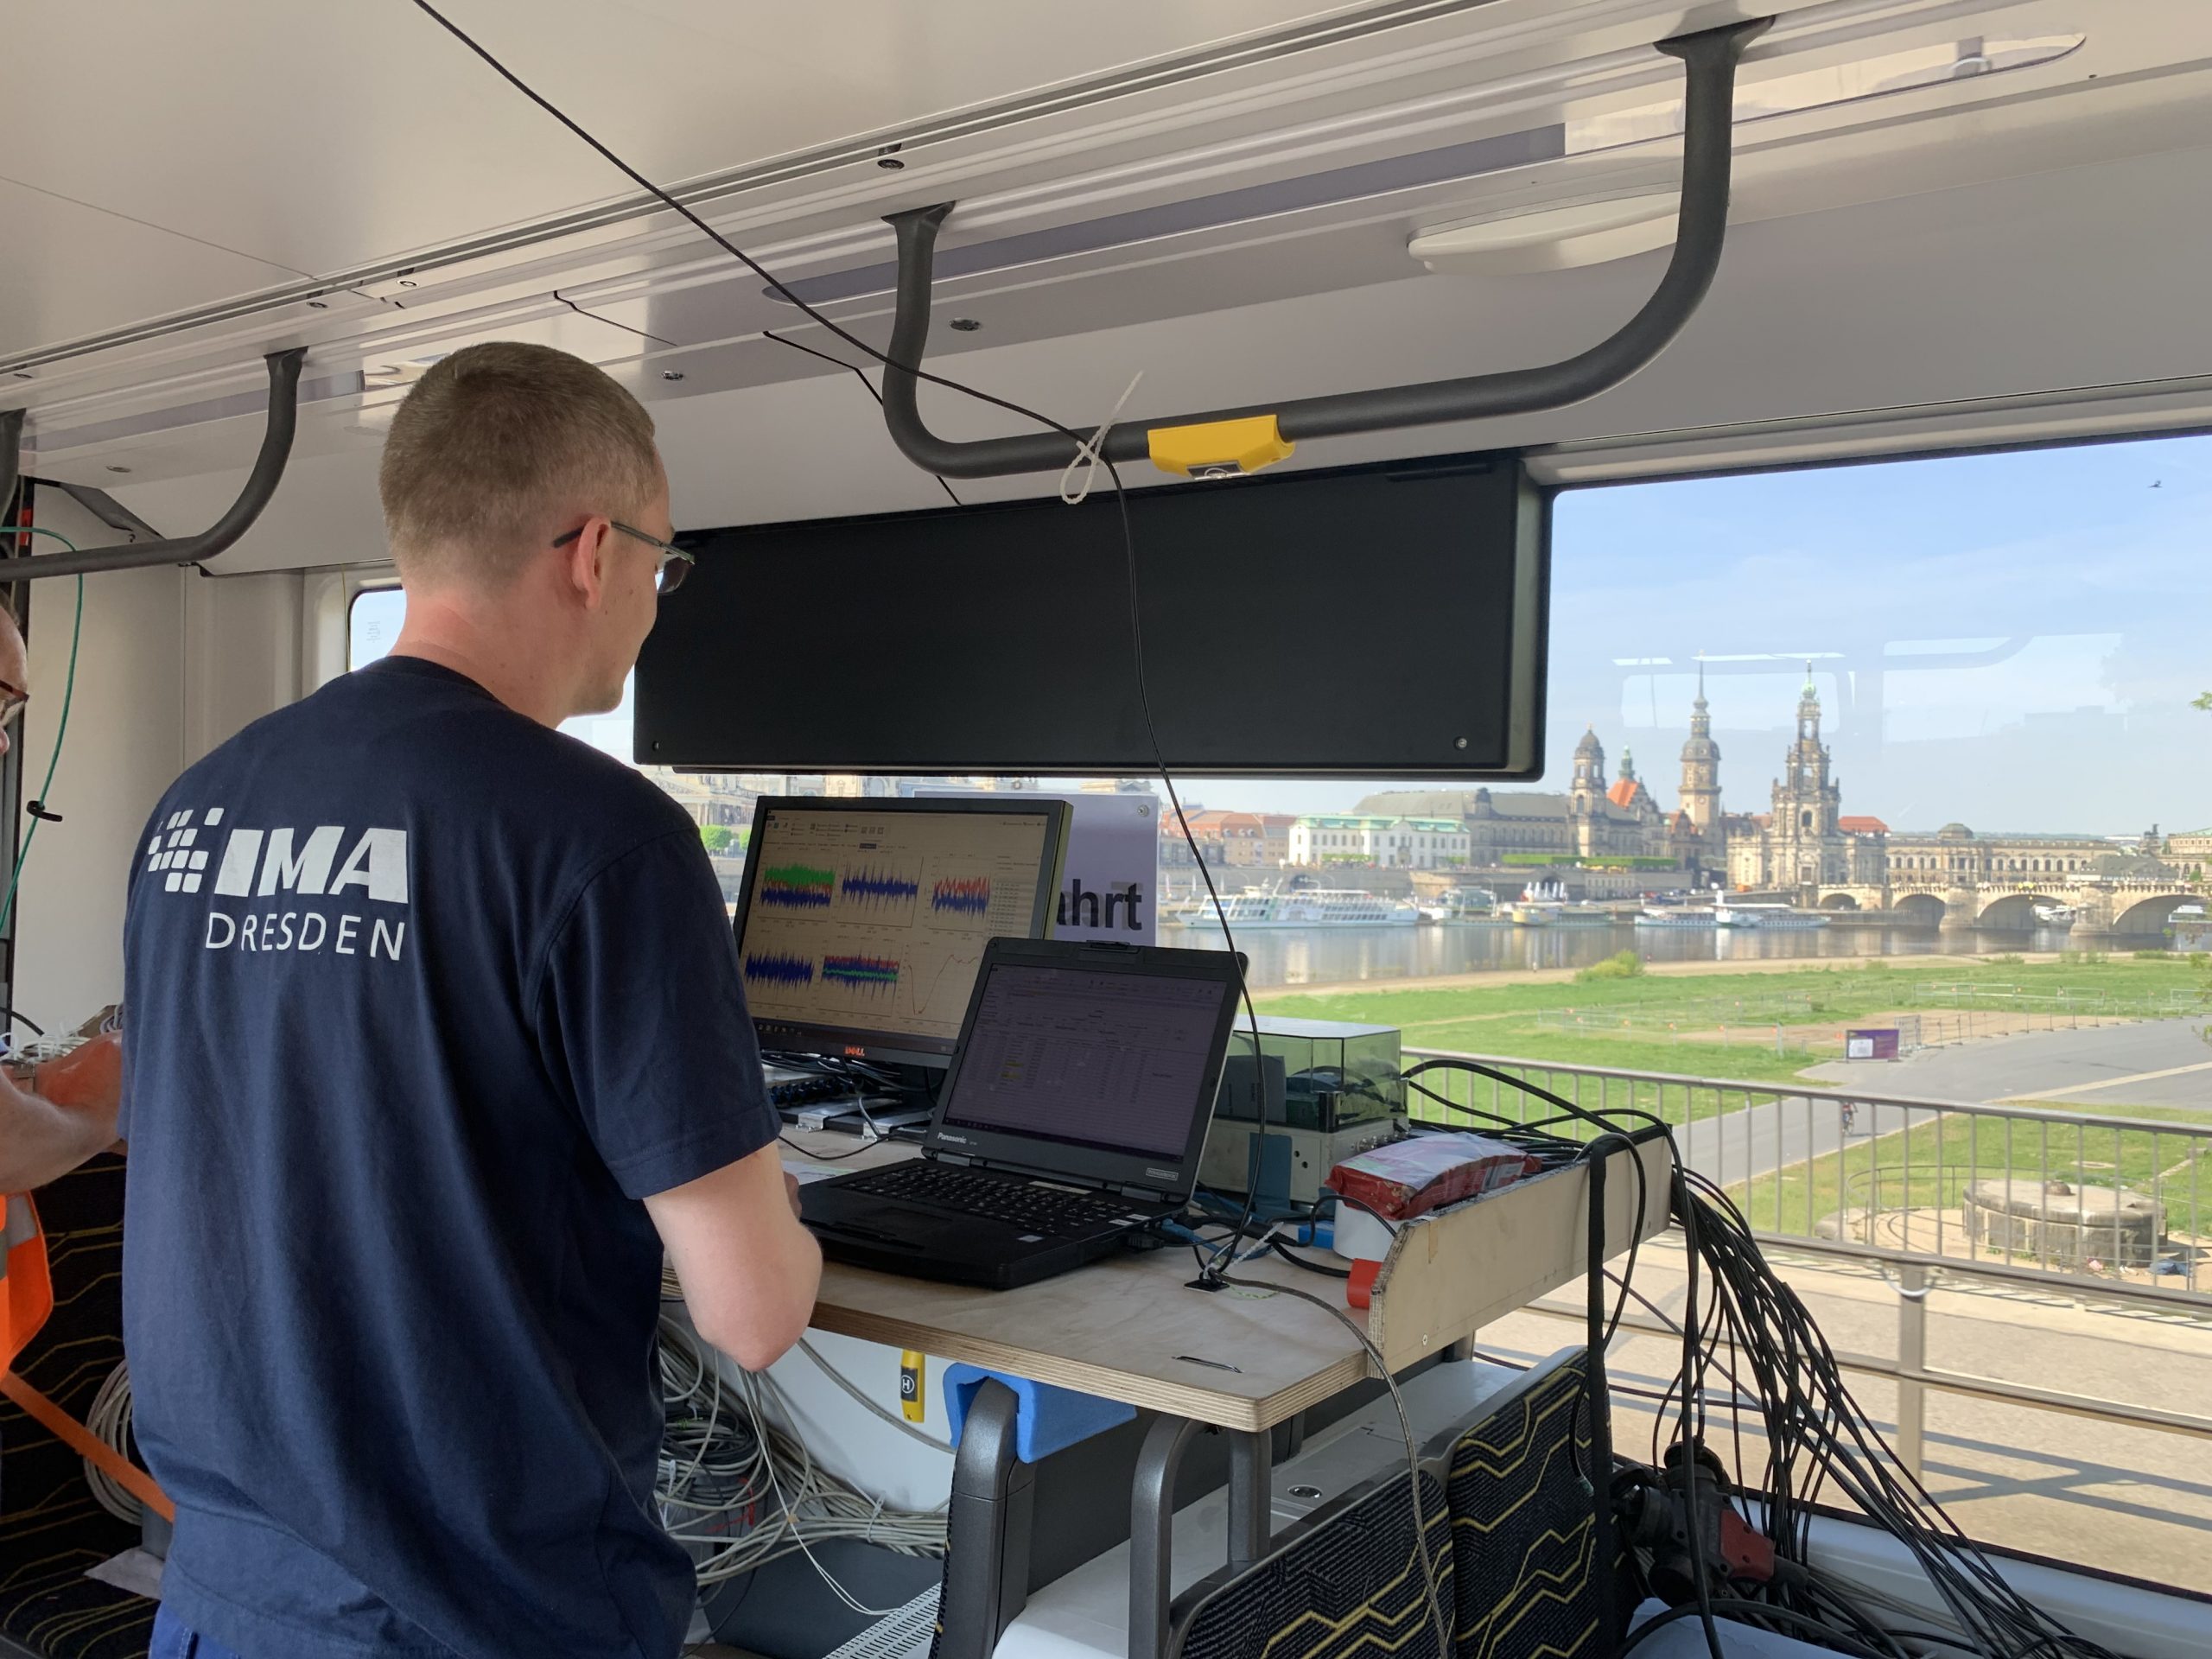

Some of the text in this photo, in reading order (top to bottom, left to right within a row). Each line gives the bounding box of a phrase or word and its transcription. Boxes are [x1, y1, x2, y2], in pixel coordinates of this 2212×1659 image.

[215, 826, 408, 903] IMA
[206, 912, 404, 961] DRESDEN
[937, 1132, 967, 1144] Panasonic
[902, 1379, 910, 1390] H
